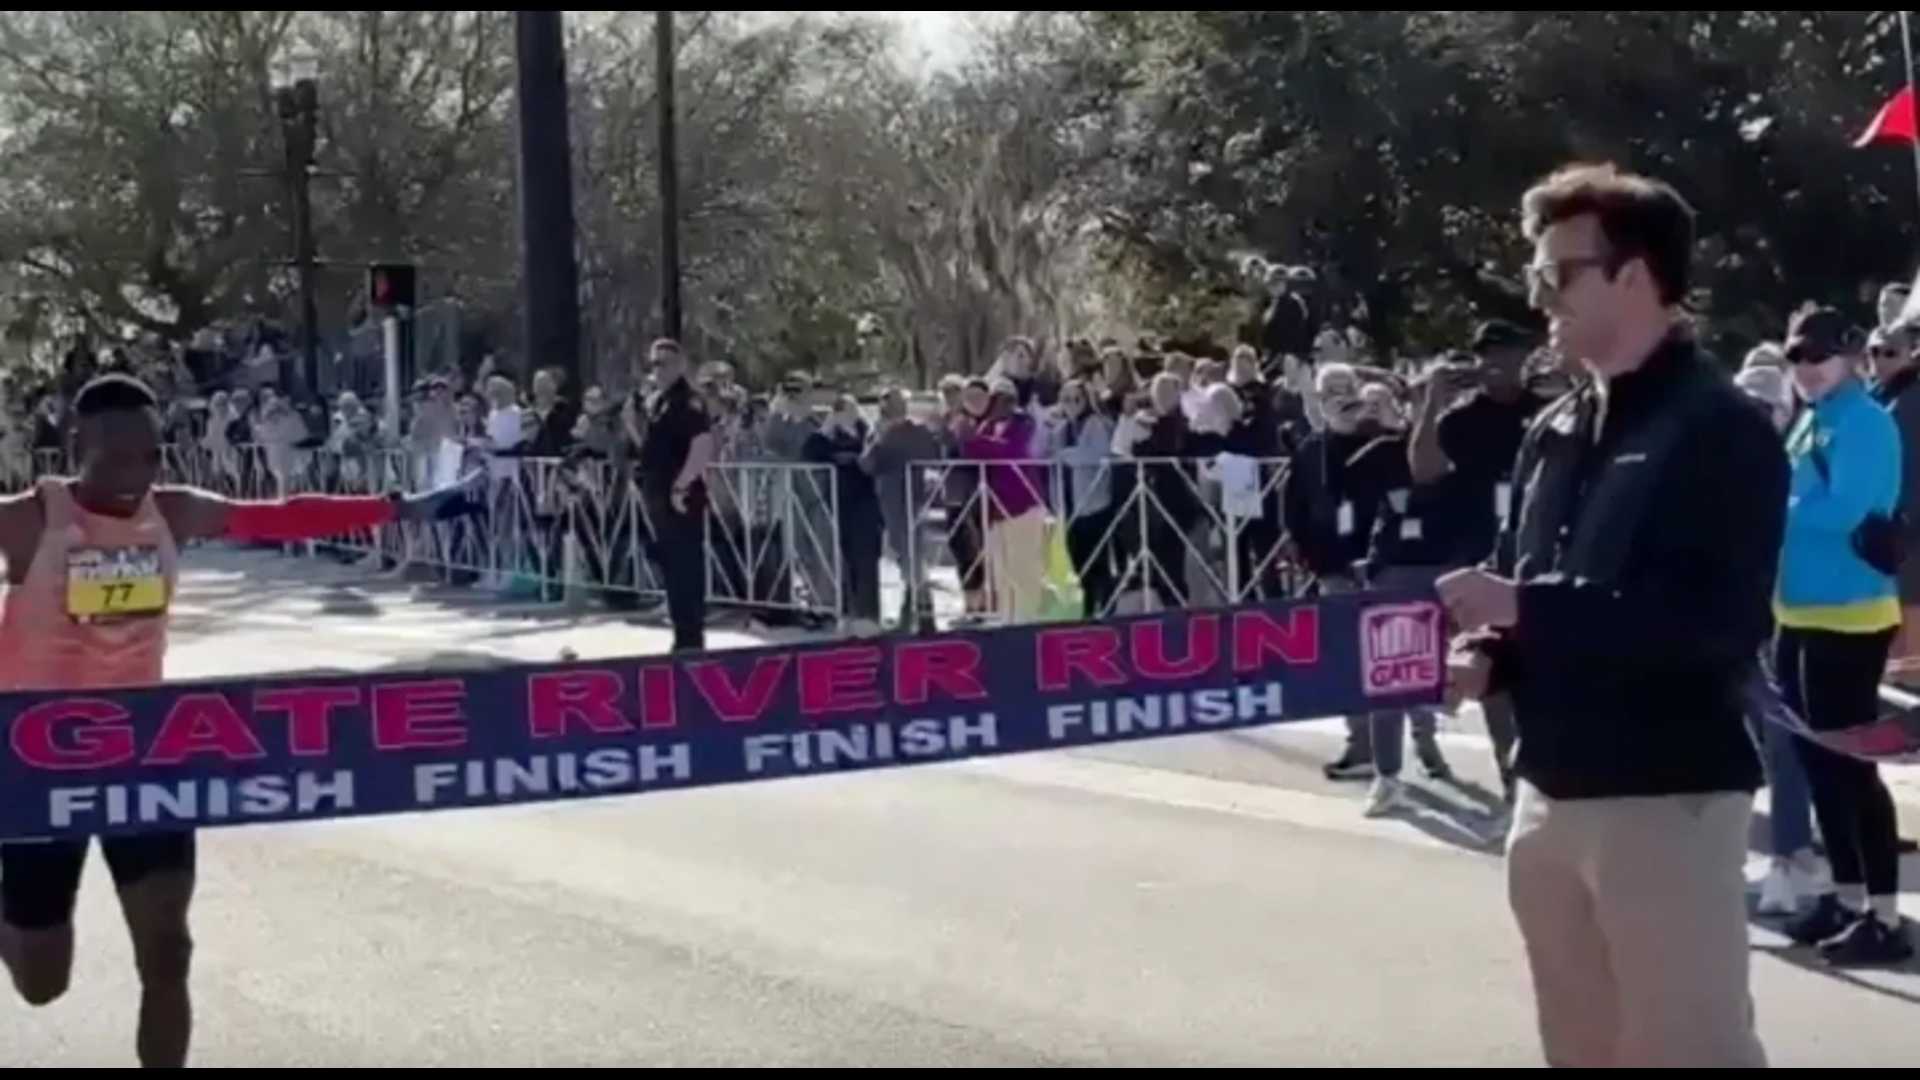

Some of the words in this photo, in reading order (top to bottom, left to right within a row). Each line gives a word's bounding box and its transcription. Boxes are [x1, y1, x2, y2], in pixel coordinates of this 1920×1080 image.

[101, 582, 135, 607] 77
[10, 678, 468, 770] GATE
[528, 636, 989, 738] RIVER
[1036, 605, 1320, 691] RUN
[1370, 660, 1434, 687] GATE
[49, 769, 355, 828] FINISH
[414, 743, 691, 803] FINISH
[744, 712, 998, 772] FINISH
[1047, 682, 1283, 740] FINISH
